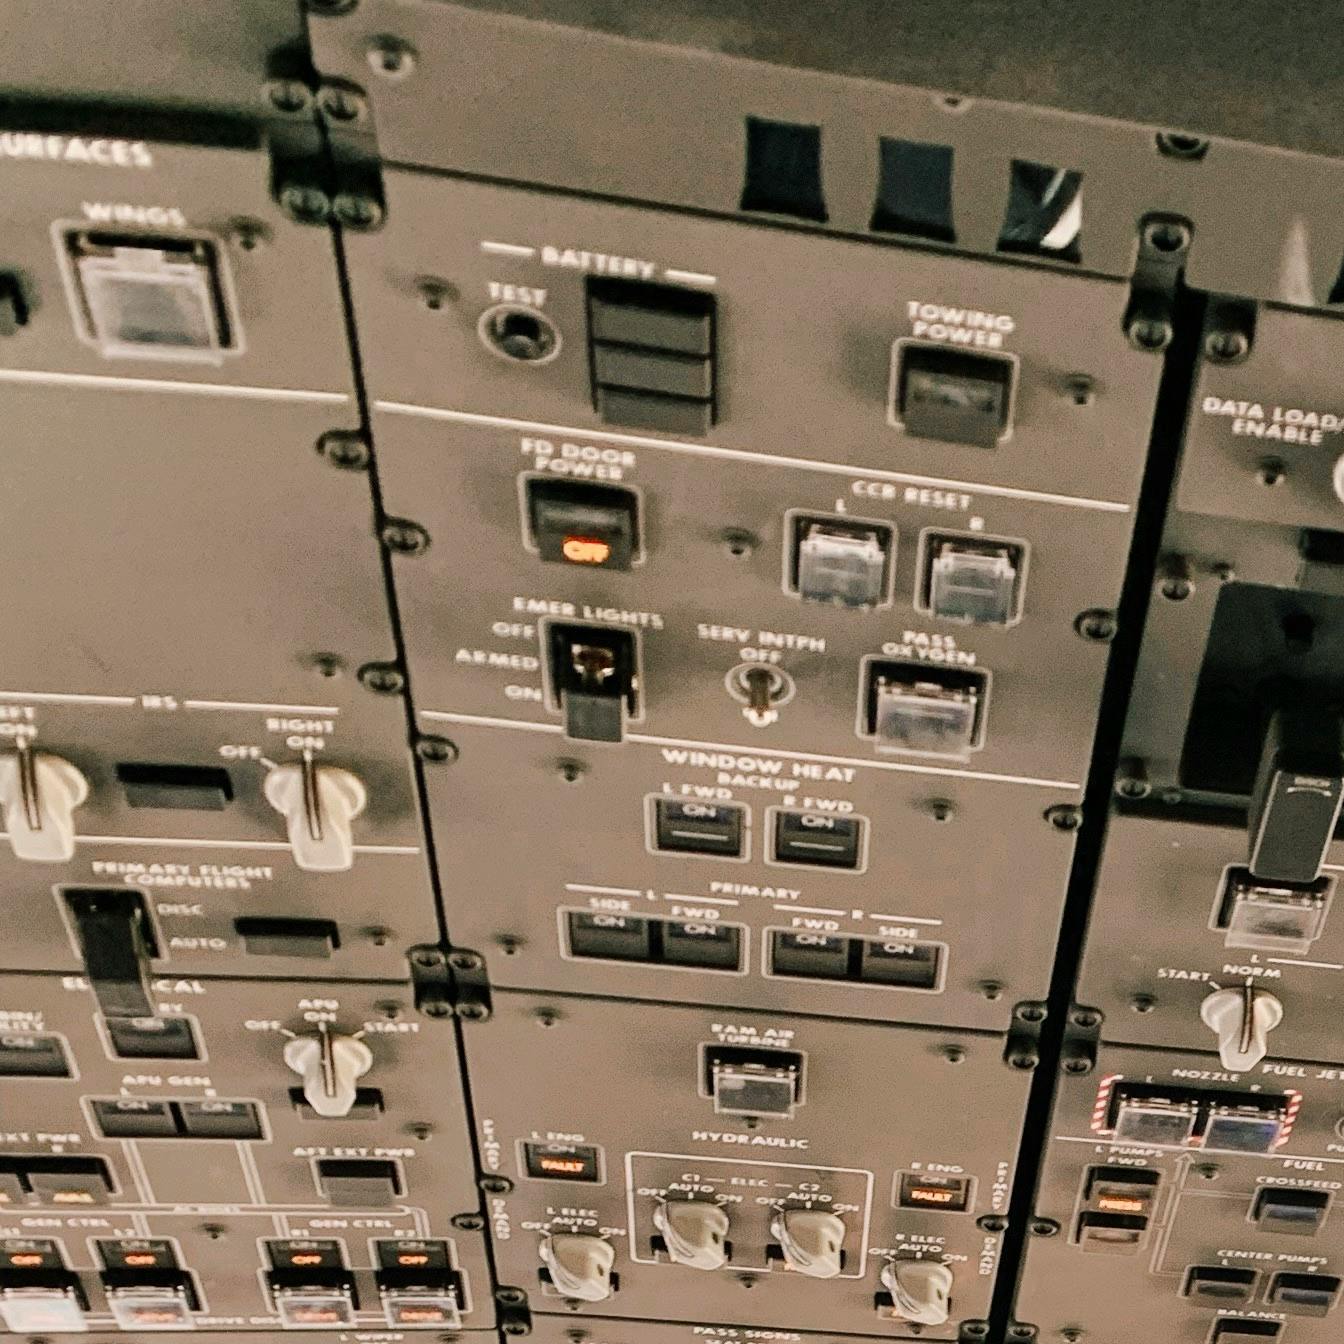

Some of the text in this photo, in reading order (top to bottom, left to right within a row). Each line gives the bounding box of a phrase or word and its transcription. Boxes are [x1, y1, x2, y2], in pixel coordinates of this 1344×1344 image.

[0, 132, 152, 167] URFACES
[542, 246, 655, 279] BATTERY
[489, 282, 547, 306] TEST
[906, 302, 1015, 332] TOWING
[912, 322, 1002, 348] POWER
[1202, 396, 1267, 421] DATA
[1232, 419, 1323, 447] ENABLE
[562, 444, 637, 467] DOOR
[535, 455, 624, 480] POWER
[513, 598, 663, 629] EMER LIGHTS
[902, 631, 955, 648] PASS
[455, 649, 538, 670] ARMED
[882, 642, 976, 665] OXYGEN
[266, 718, 334, 734] RIGHT
[219, 745, 262, 759] OFF
[286, 736, 324, 750] ON
[661, 748, 856, 783] WINDOW HEAT
[717, 773, 800, 791] BACKUP
[92, 861, 273, 879] PRIMARY FLIGHT
[123, 874, 250, 889] COMPUTERS
[711, 881, 801, 900] PRIMARY
[1223, 963, 1281, 979] NORM
[1262, 1063, 1307, 1080] FUEL
[692, 1131, 809, 1150] HYDRAULIC
